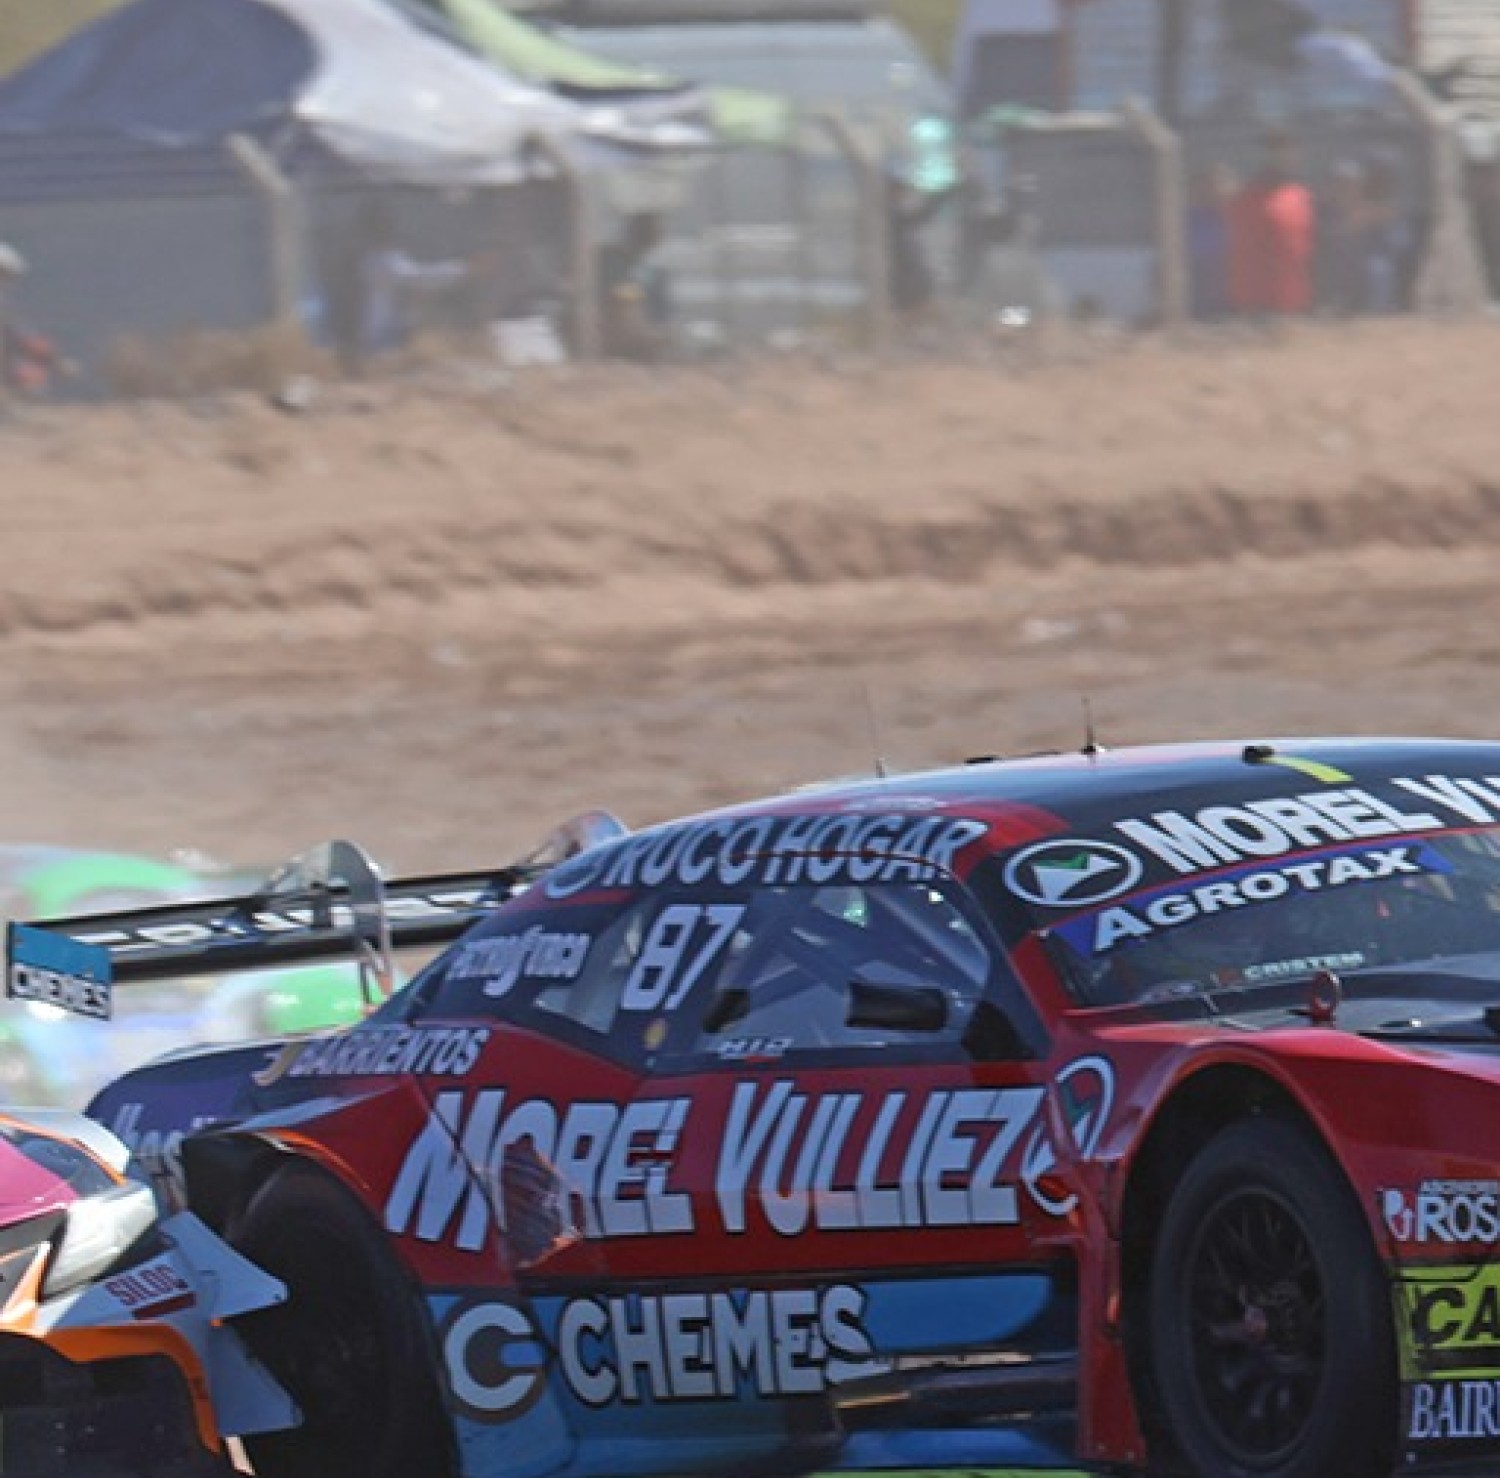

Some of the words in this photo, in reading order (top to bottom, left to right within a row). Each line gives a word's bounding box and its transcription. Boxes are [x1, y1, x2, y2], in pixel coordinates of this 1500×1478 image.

[763, 815, 988, 884] HOGAR
[1113, 787, 1445, 874] MOREL
[1095, 847, 1421, 951] AGROTAX
[621, 904, 747, 1010] 87
[713, 1078, 1047, 1236] VULLIEZ
[558, 1285, 892, 1405] CHEMES
